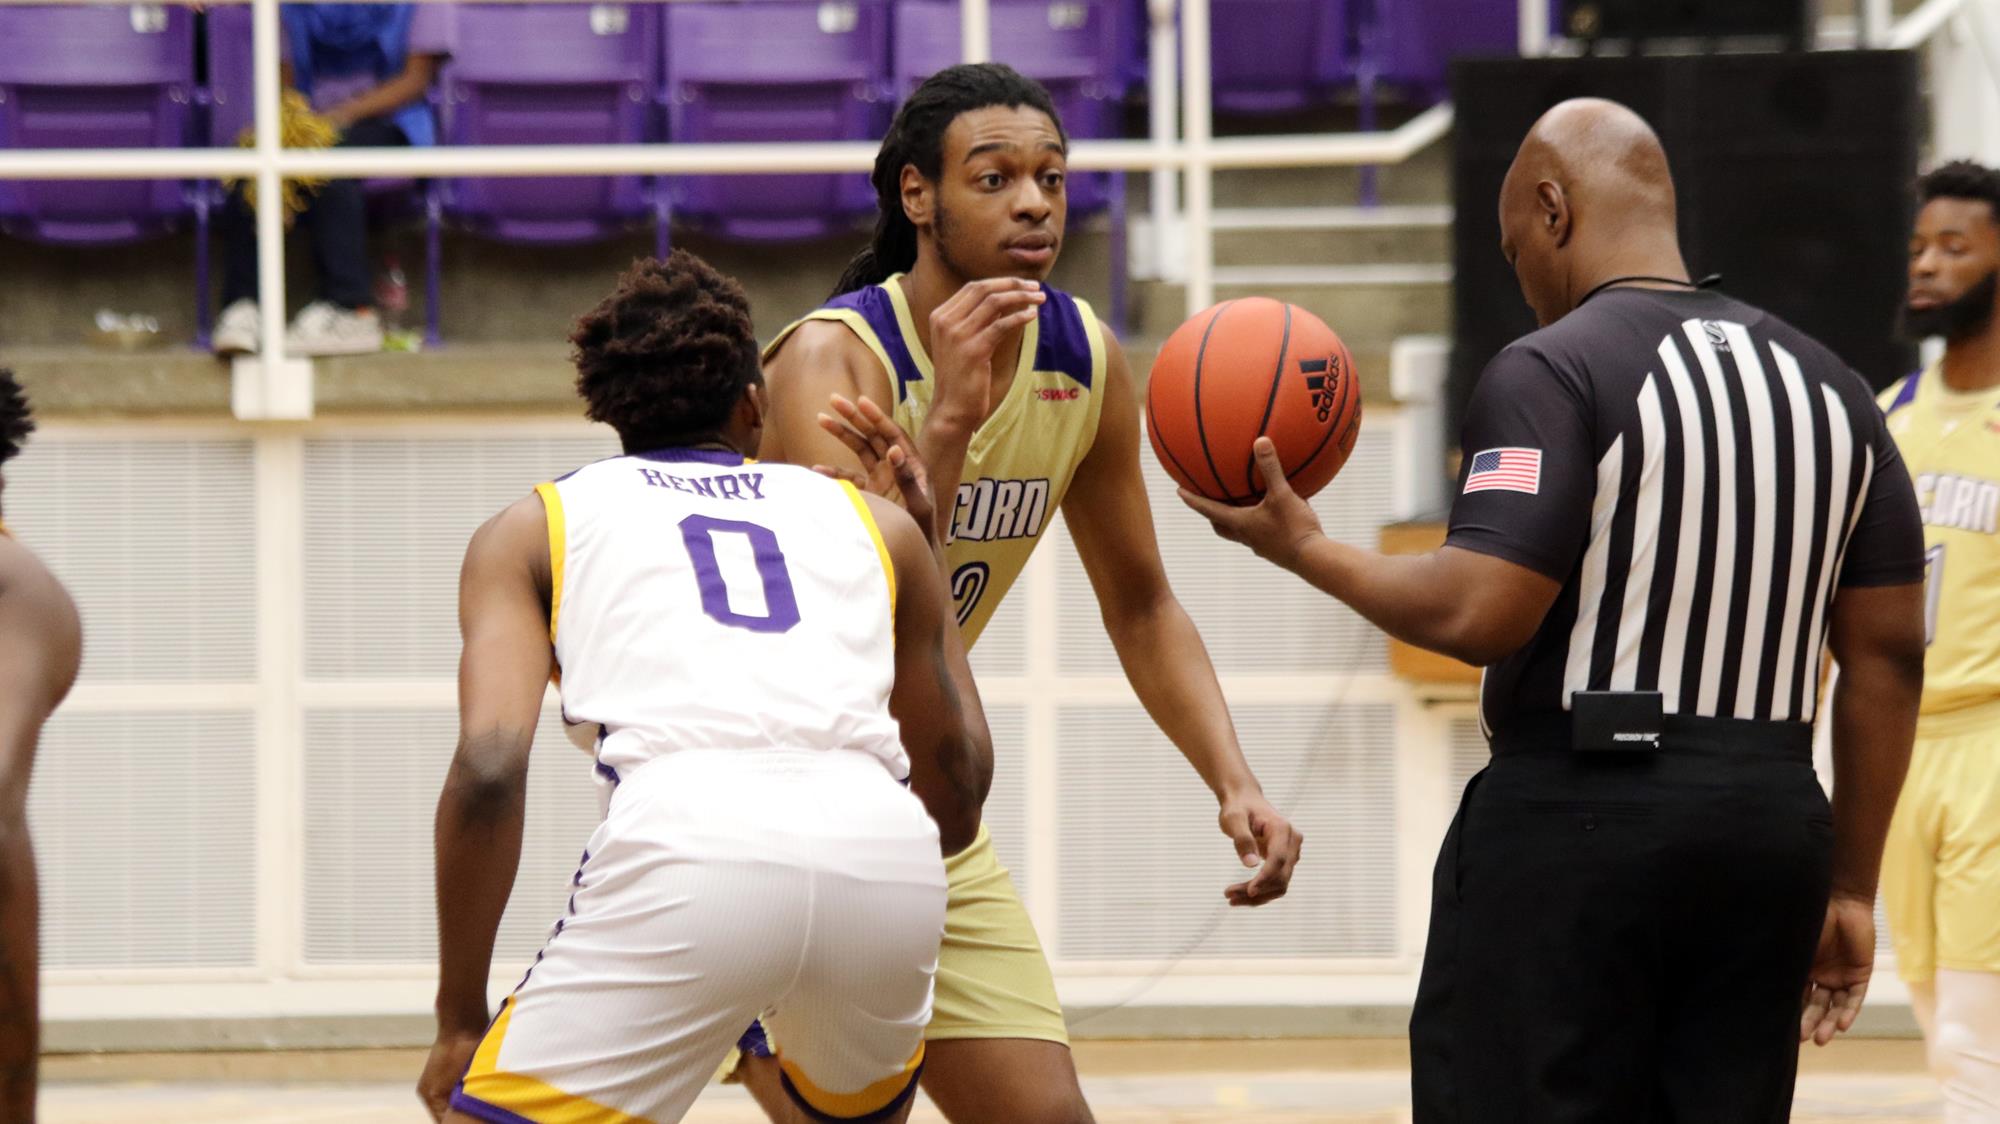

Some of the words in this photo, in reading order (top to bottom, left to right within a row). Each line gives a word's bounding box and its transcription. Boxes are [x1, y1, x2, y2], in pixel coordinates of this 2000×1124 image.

[1041, 387, 1080, 401] SWAC
[1316, 352, 1340, 423] adidas
[637, 468, 766, 501] HENRY
[677, 513, 801, 634] 0
